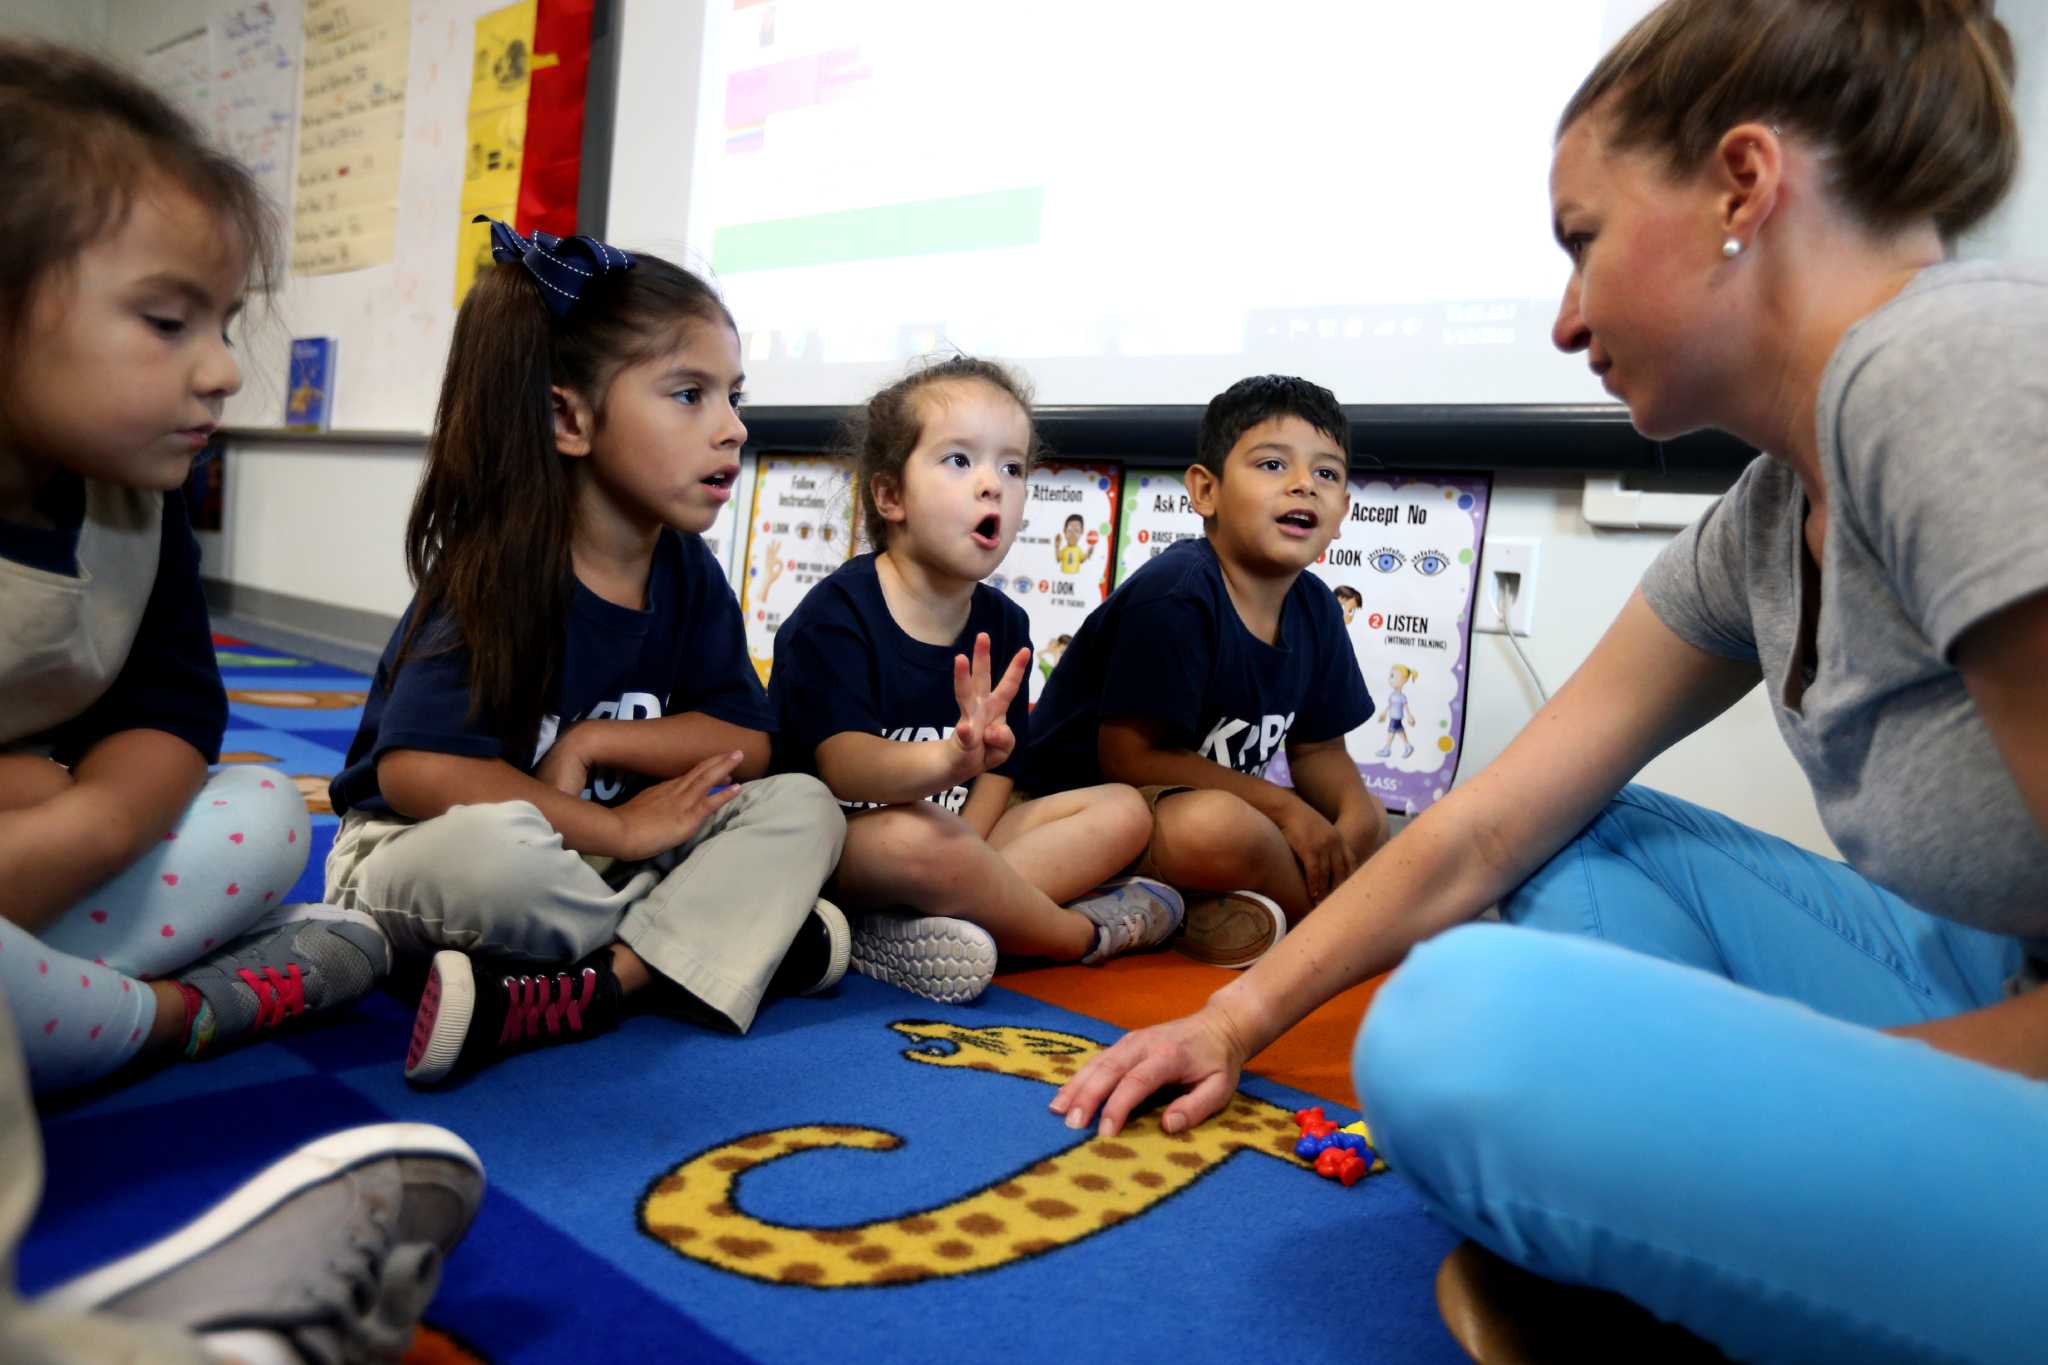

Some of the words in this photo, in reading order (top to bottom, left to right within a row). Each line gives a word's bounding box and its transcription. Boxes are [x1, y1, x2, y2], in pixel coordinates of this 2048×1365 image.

[1033, 485, 1083, 502] Attention
[1153, 494, 1174, 513] Ask
[1351, 502, 1399, 526] Accept
[1407, 504, 1427, 525] No
[1329, 549, 1362, 567] LOOK
[1051, 580, 1075, 595] LOOK
[1386, 614, 1428, 634] LISTEN
[1384, 635, 1415, 647] (WITHOUT
[1417, 638, 1447, 650] TALKING)
